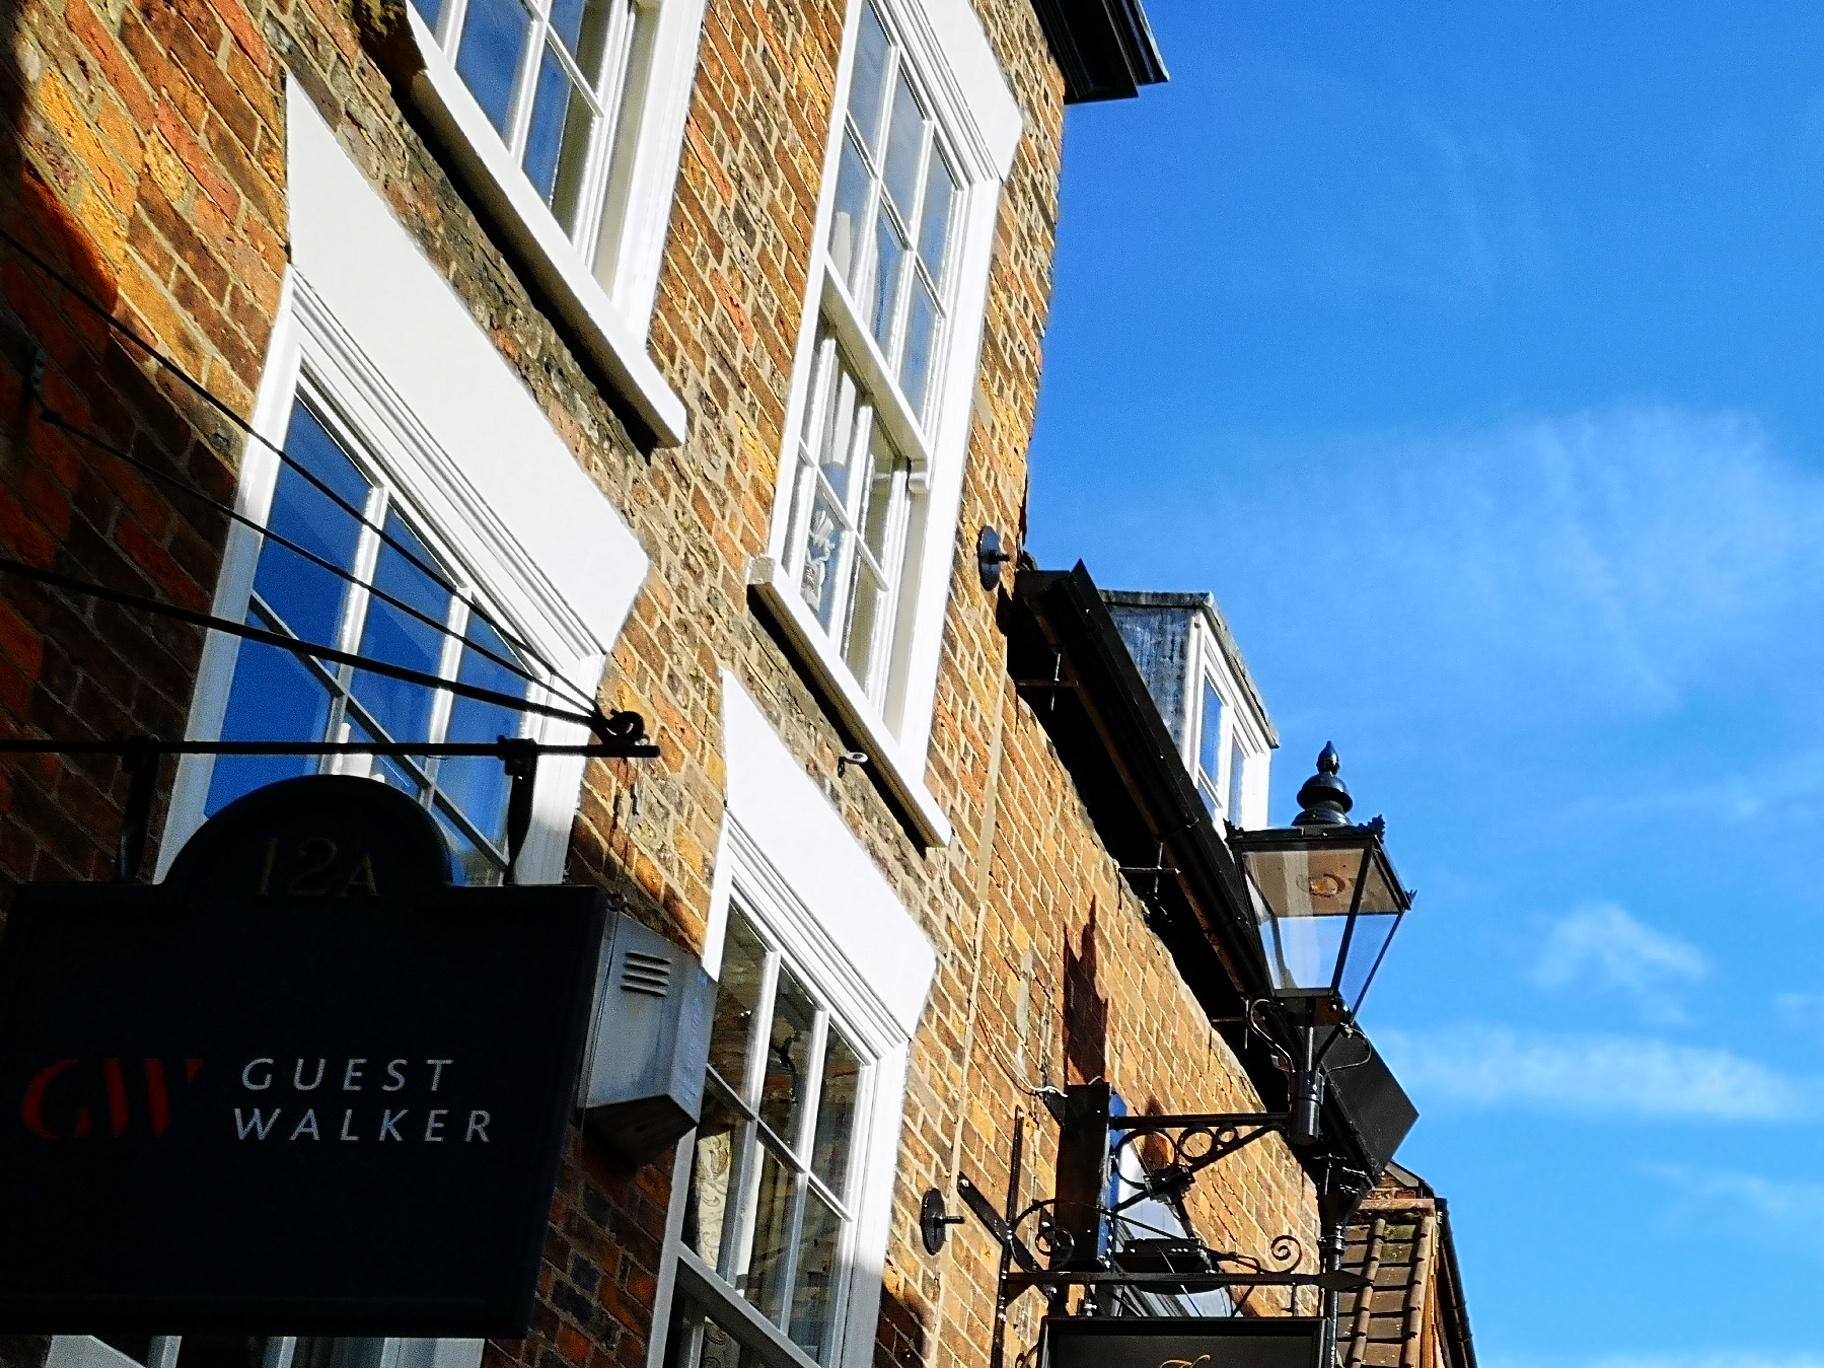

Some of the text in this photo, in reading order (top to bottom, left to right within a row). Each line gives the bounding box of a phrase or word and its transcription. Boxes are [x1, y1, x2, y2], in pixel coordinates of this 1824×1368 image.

[256, 836, 380, 898] 12A
[241, 1057, 454, 1092] GUEST
[233, 1107, 492, 1143] WALKER
